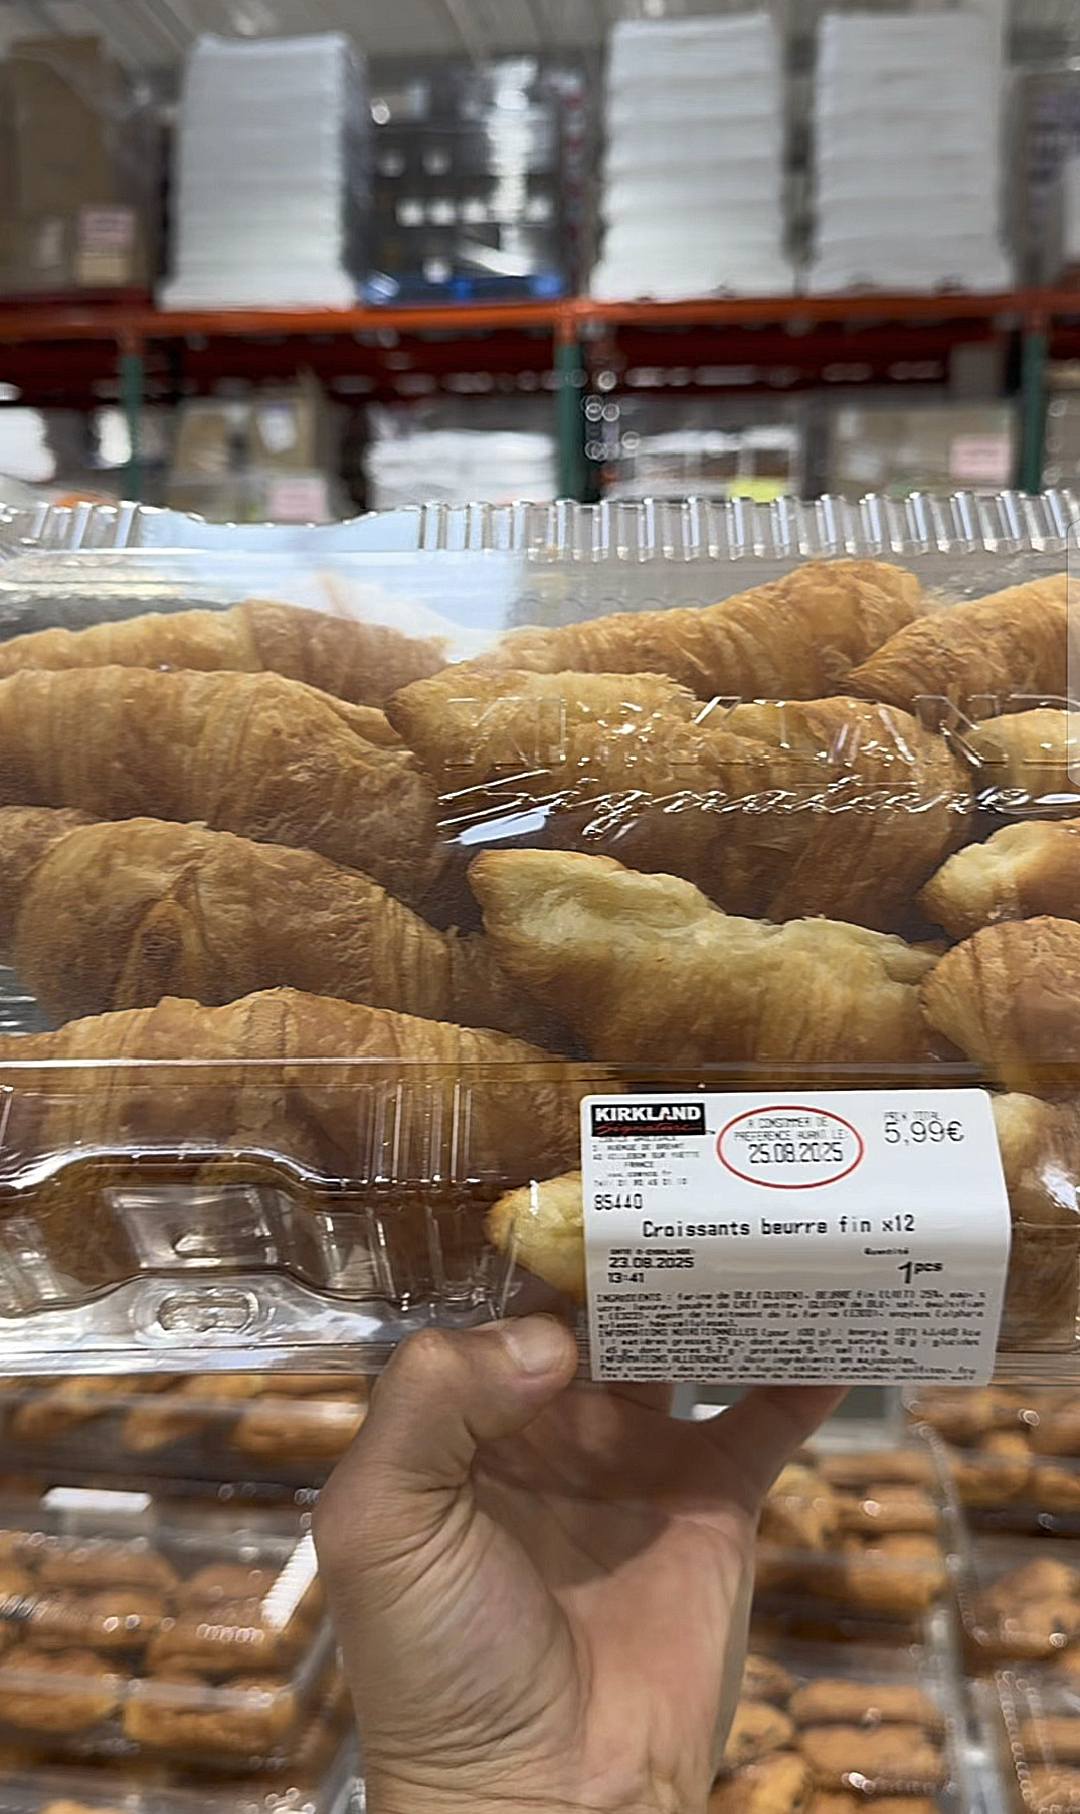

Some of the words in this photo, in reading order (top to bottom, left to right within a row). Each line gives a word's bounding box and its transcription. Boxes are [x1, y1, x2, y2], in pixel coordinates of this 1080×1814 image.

[594, 1106, 702, 1122] KIRKLAND
[642, 1221, 750, 1238] Croissants
[761, 1217, 827, 1235] beurre
[839, 1215, 871, 1233] fin
[882, 1214, 915, 1231] x12
